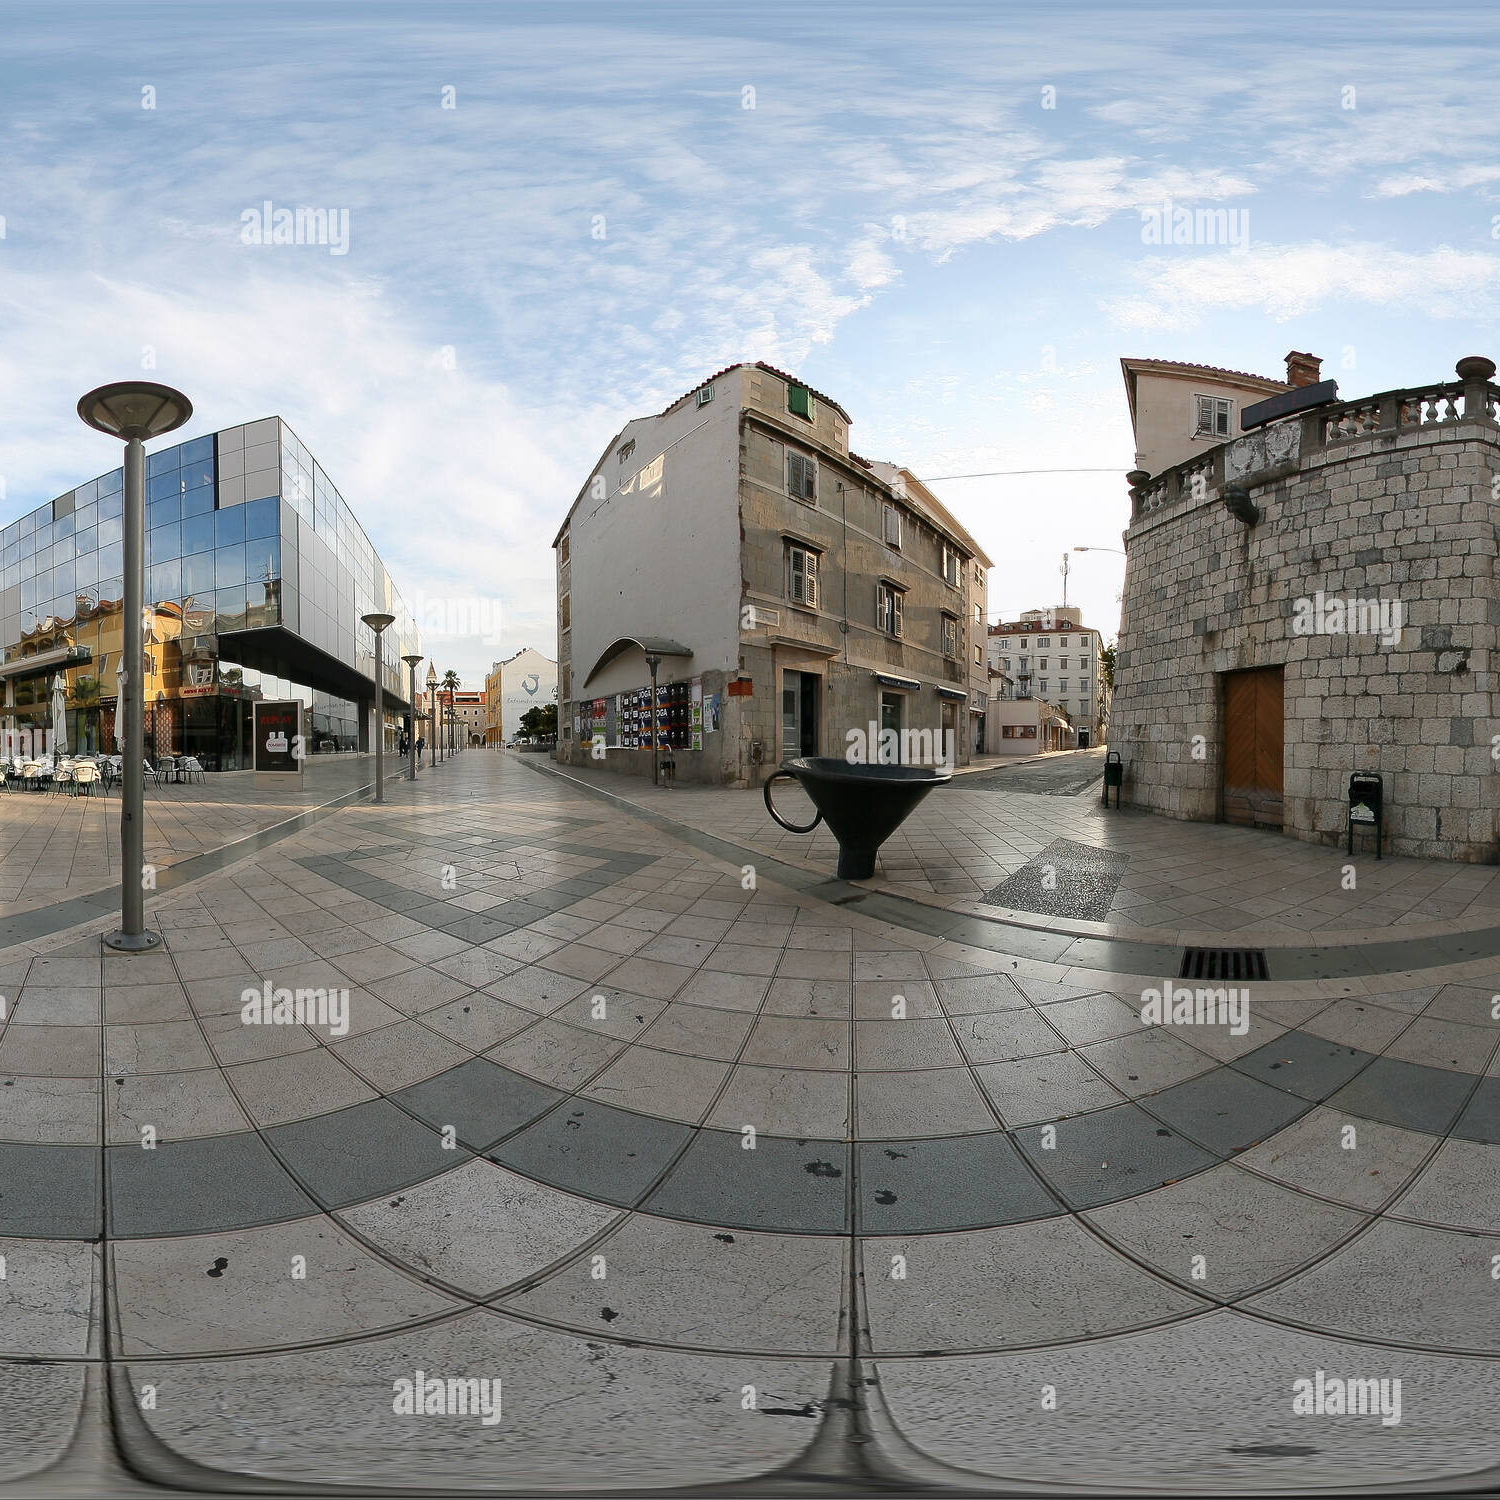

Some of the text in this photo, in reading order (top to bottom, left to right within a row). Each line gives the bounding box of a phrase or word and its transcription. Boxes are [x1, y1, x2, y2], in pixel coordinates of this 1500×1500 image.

[638, 690, 652, 699] JOGA
[655, 687, 668, 696] OGA
[638, 710, 652, 719] JOGA
[655, 709, 668, 718] OGA
